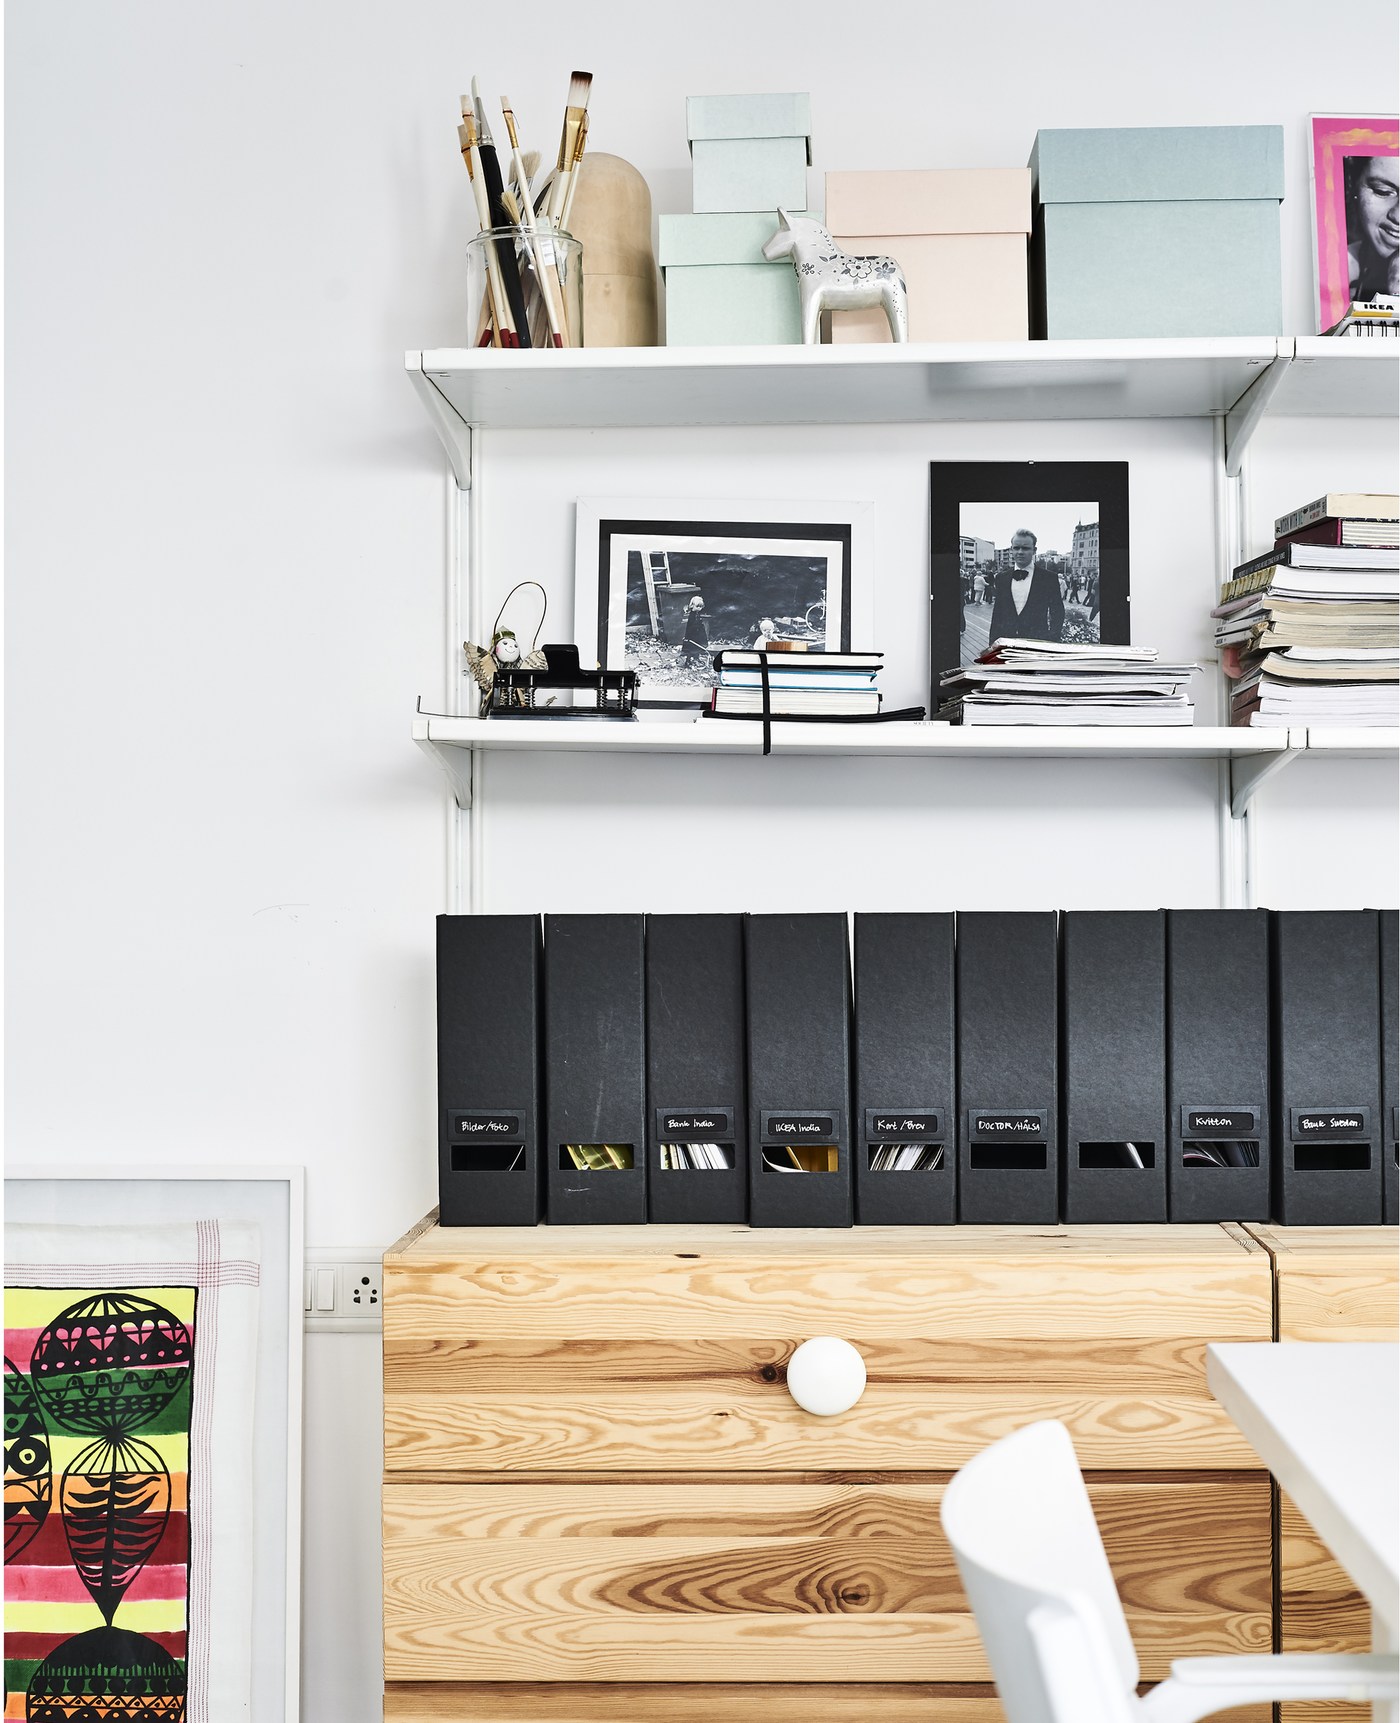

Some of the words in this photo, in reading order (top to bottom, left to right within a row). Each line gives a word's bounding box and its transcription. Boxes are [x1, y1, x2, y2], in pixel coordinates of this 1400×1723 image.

[1364, 303, 1395, 311] IKEA
[667, 1119, 690, 1128] Bank
[693, 1118, 715, 1128] India
[775, 1123, 797, 1132] IKEA
[798, 1123, 821, 1132] India
[1301, 1118, 1327, 1129] Bank
